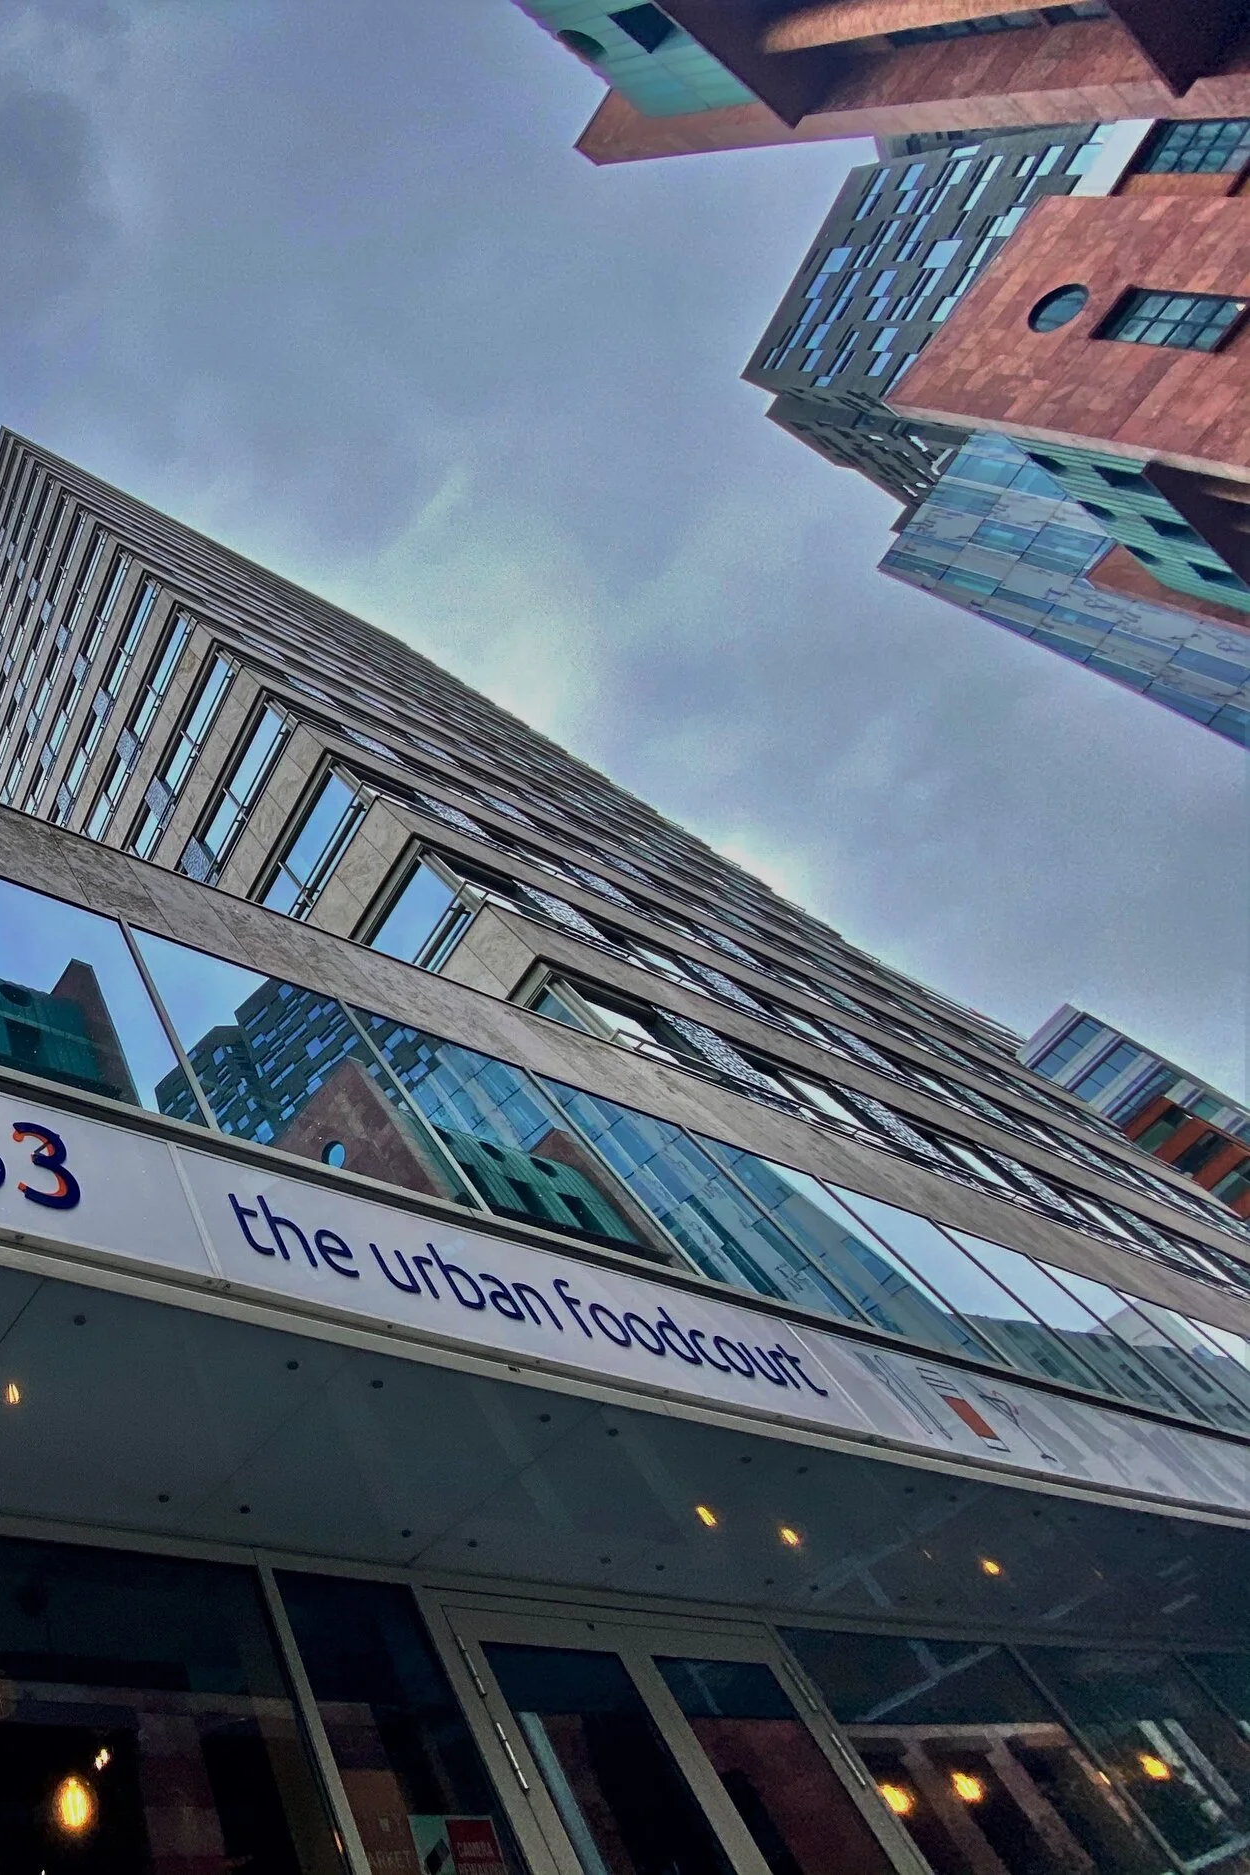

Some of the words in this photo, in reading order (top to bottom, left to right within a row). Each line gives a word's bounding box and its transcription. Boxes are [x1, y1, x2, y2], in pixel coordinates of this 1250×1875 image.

[228, 1192, 360, 1279] the
[369, 1242, 564, 1332] urban
[553, 1278, 829, 1397] foodcourt
[456, 1840, 495, 1857] CAMERA
